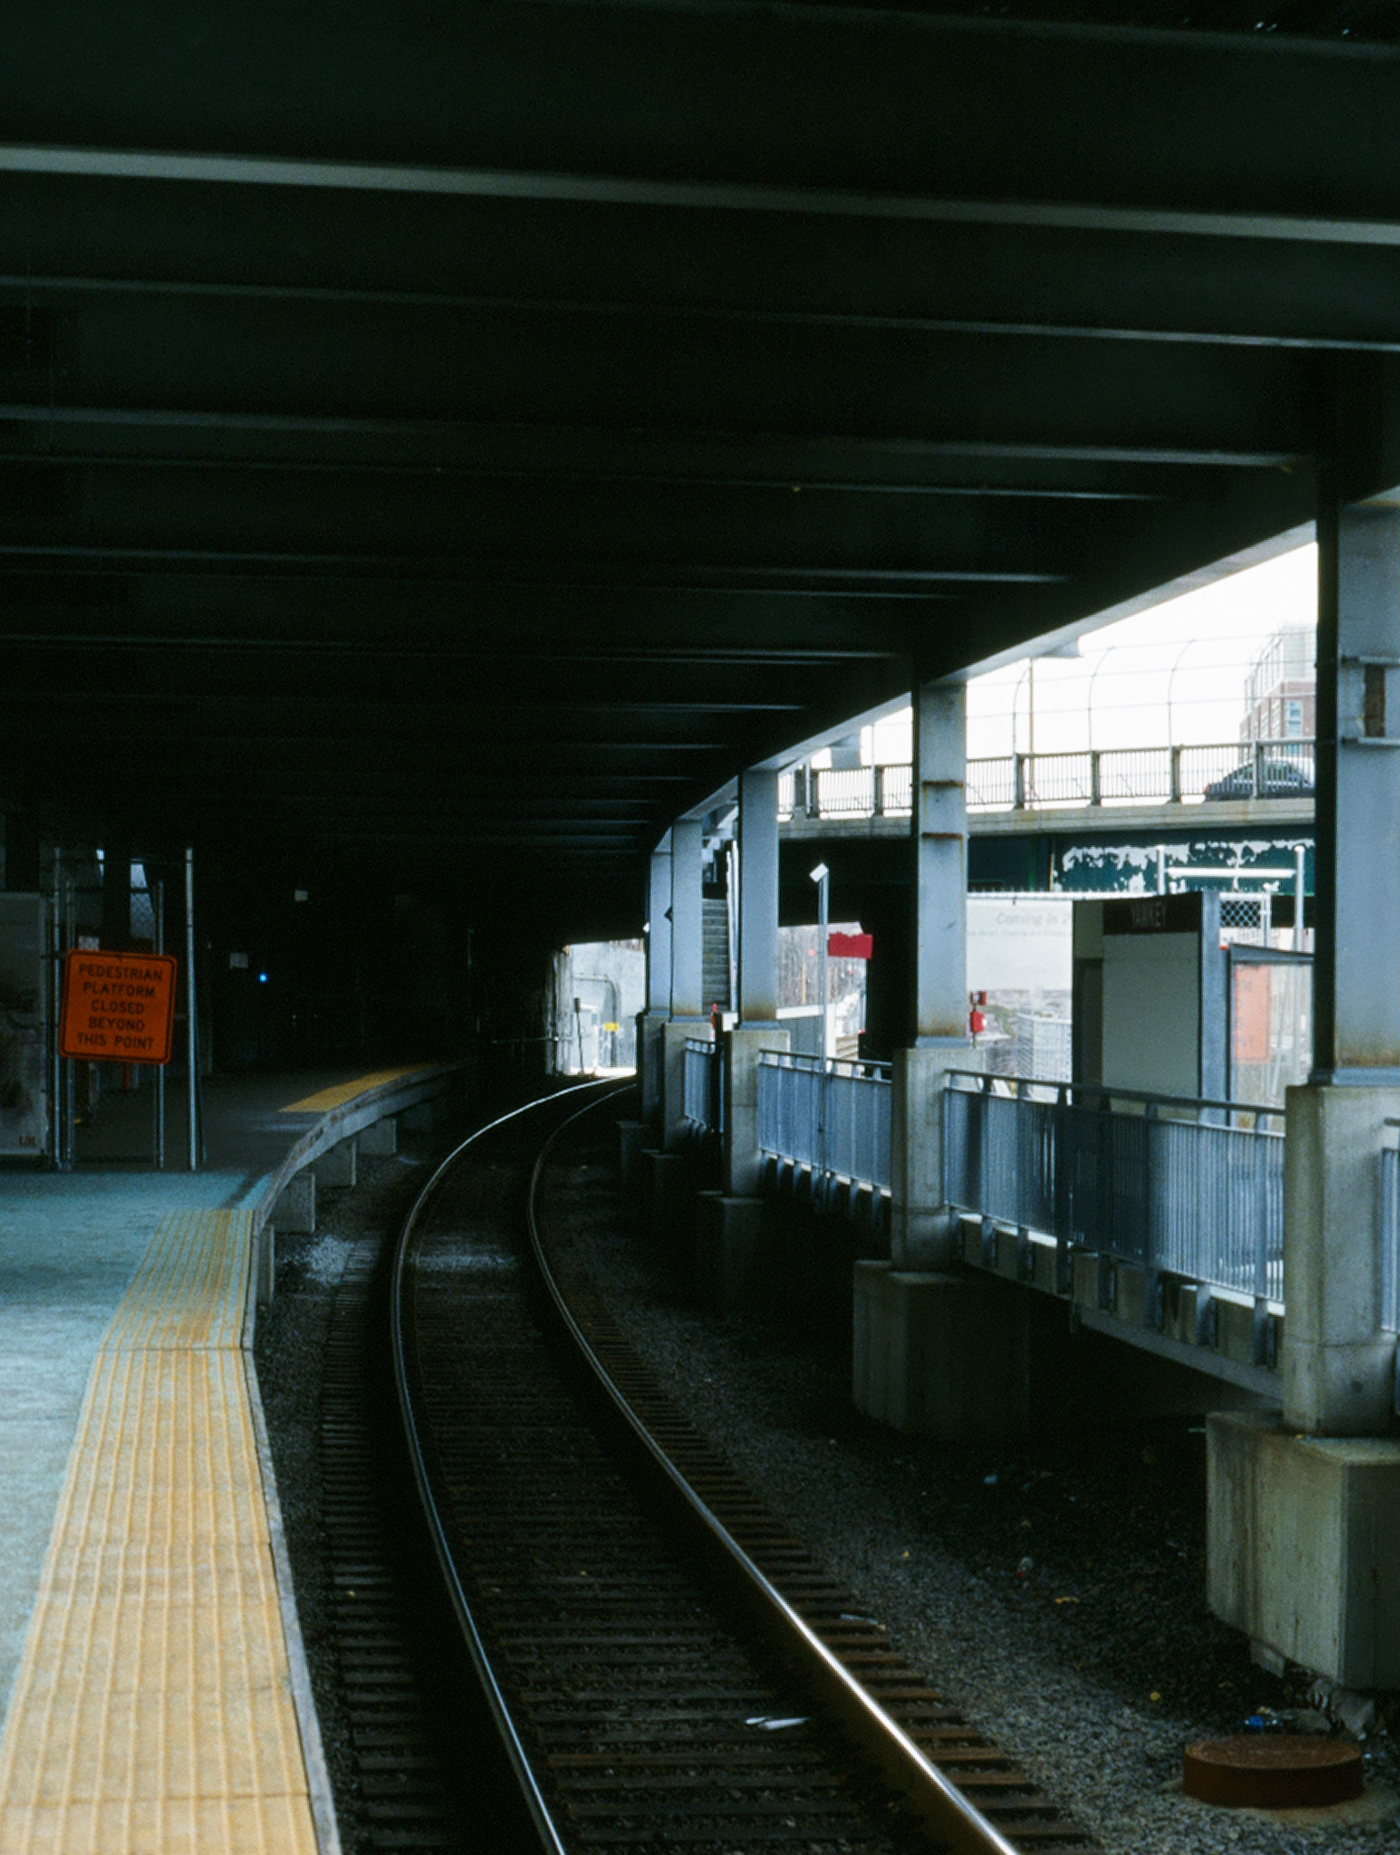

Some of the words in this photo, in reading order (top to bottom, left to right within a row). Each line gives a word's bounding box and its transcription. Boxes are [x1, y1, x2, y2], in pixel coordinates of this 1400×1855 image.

[79, 964, 162, 980] PEDESTRIAN
[83, 981, 155, 998] PLATFORM
[91, 1000, 145, 1015] CLOSED
[88, 1016, 145, 1031] BEYOND
[77, 1033, 106, 1046] THIS
[115, 1035, 154, 1050] POINT
